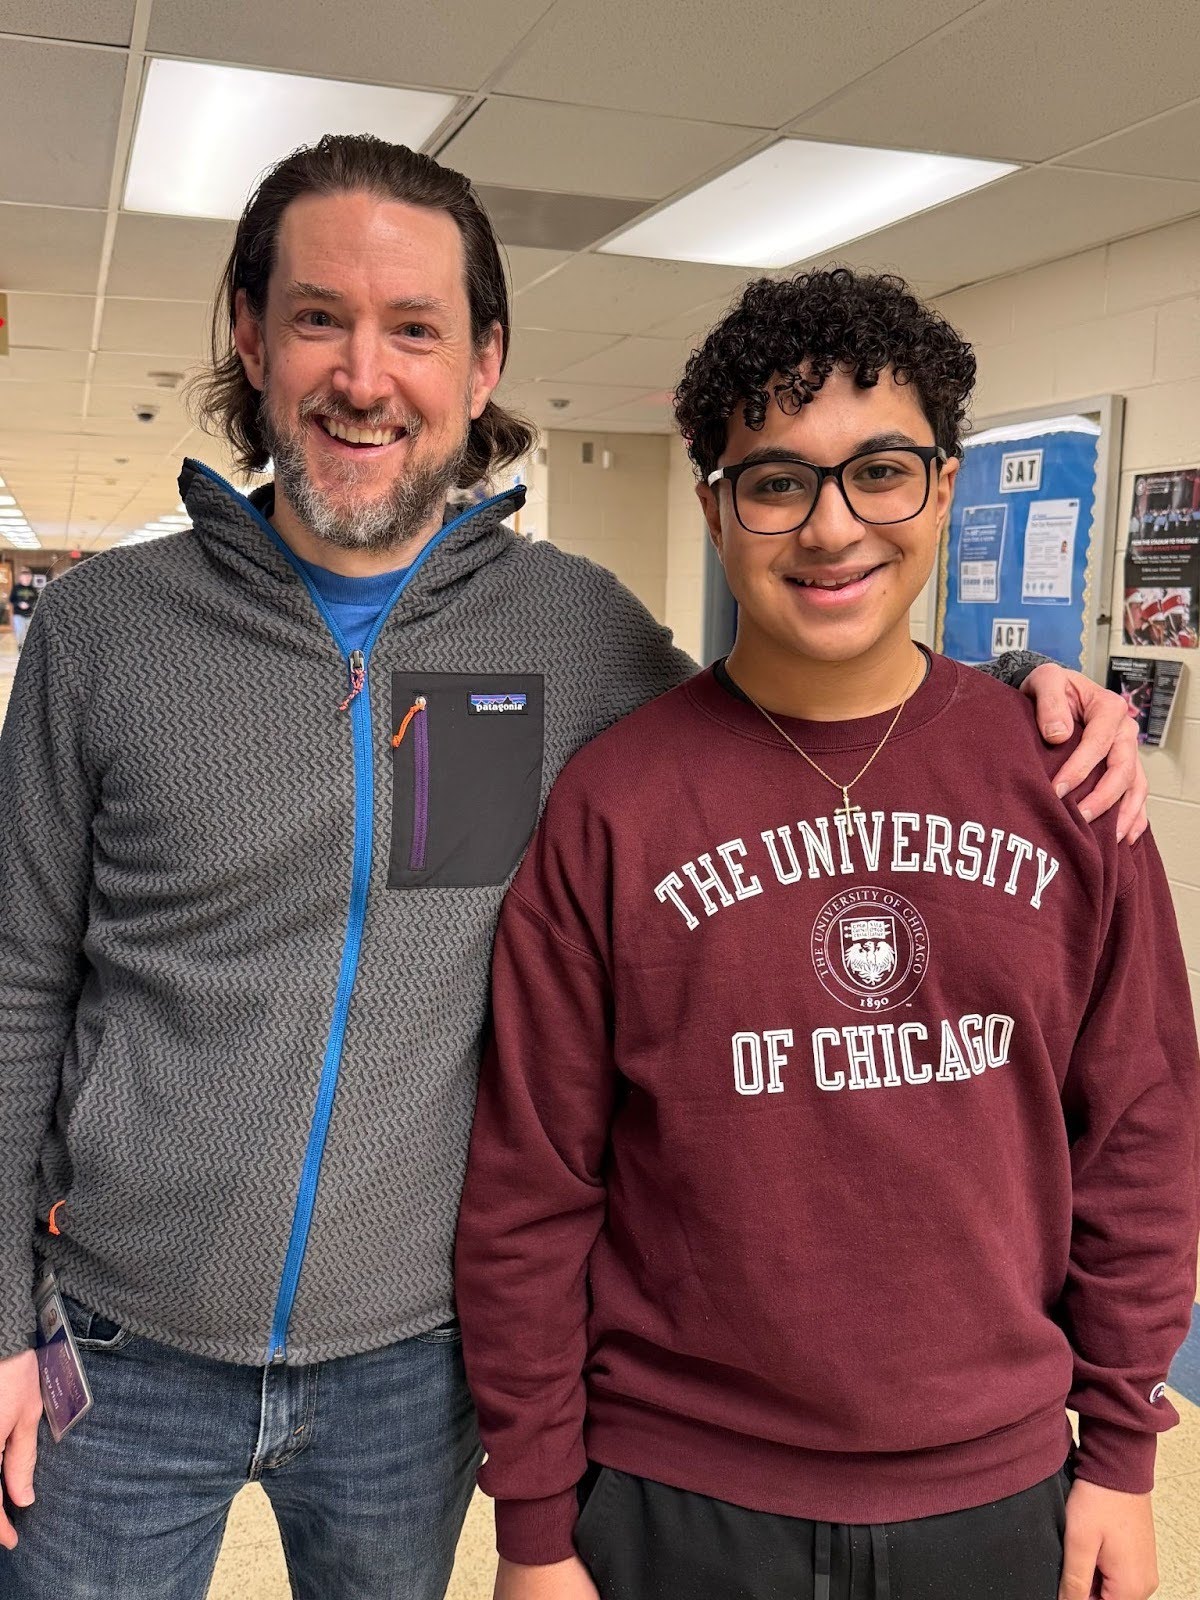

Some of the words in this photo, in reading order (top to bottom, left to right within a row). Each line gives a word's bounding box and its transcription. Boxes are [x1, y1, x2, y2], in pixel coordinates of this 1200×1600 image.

[1006, 460, 1036, 483] SAT
[995, 626, 1025, 647] ACT
[476, 703, 523, 712] patagonia
[654, 838, 763, 931] THE
[760, 811, 1060, 910] UNIVERSITY
[883, 895, 902, 908] OF
[815, 890, 879, 942] UNIVERSITY
[902, 908, 925, 974] CHICAGO
[815, 948, 829, 978] THE
[860, 997, 889, 1010] 1890
[731, 1029, 794, 1096] OF
[812, 1013, 1015, 1091] CHICAGO
